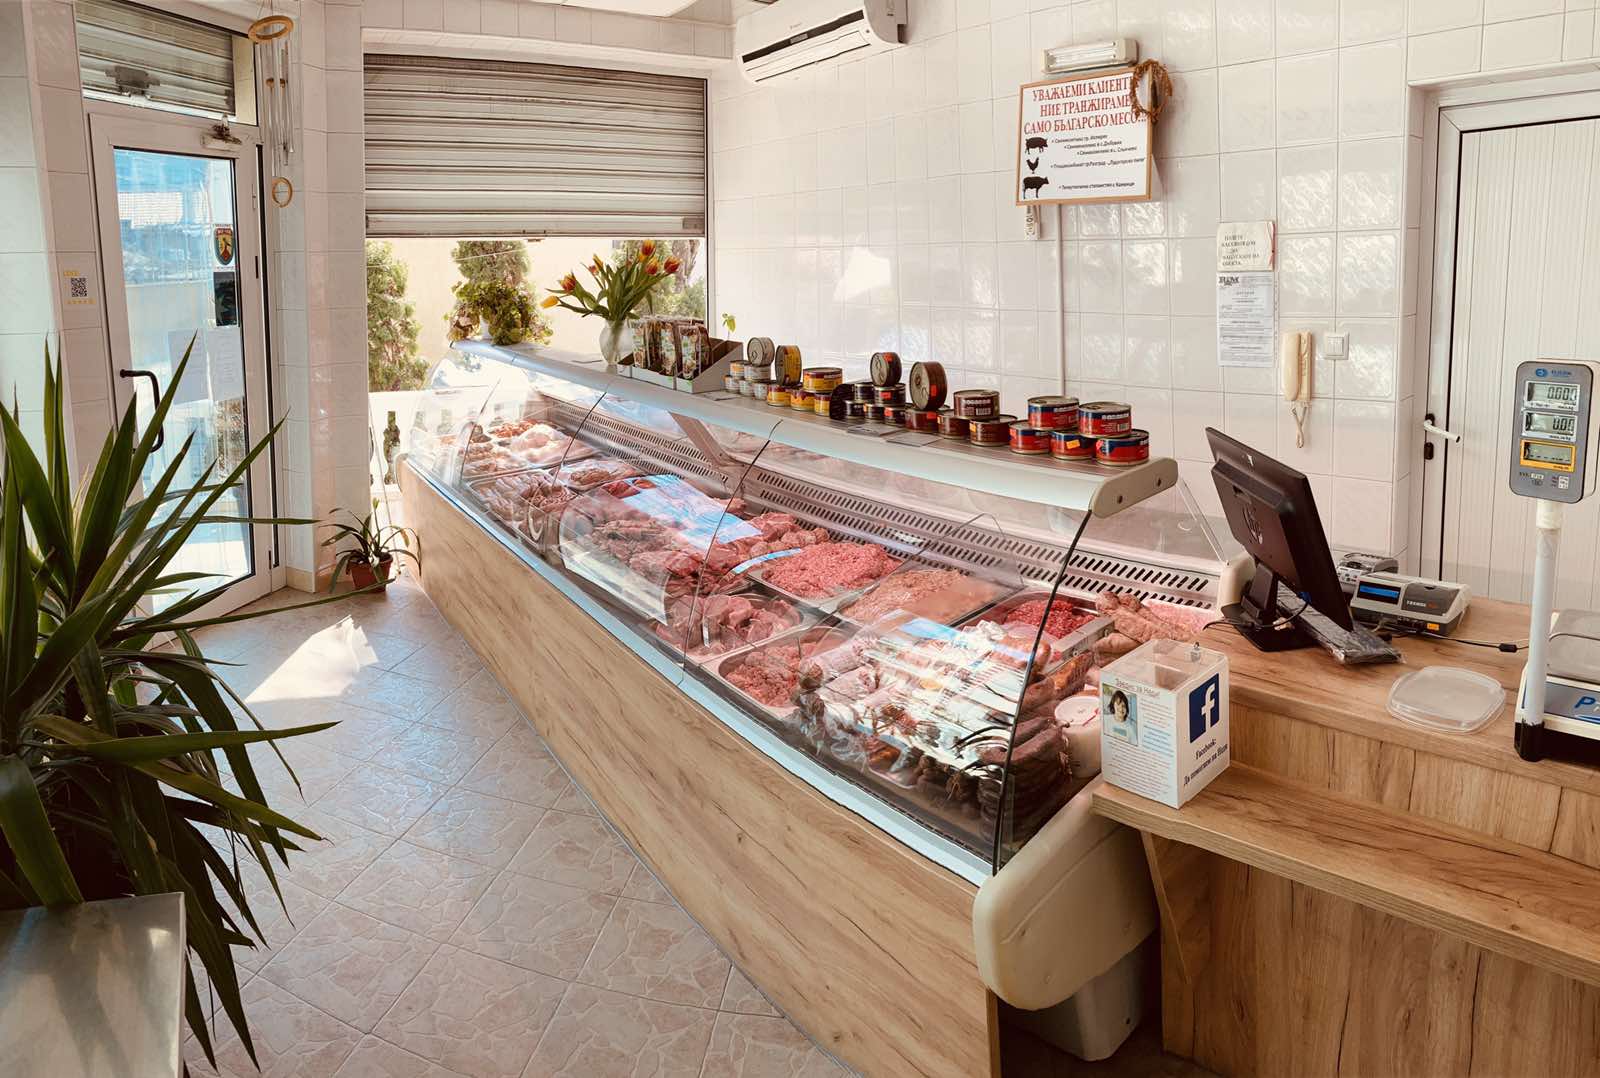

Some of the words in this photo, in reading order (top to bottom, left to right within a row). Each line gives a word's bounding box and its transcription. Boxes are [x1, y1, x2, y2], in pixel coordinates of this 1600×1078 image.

[1032, 83, 1086, 102] УВАЖАЕМИ
[1088, 76, 1131, 95] КЛИЕНТ
[1040, 102, 1064, 117] НИЕ
[1063, 94, 1131, 115] ТРАНЖИРАМЕ
[1024, 120, 1052, 135] САМО
[1054, 115, 1109, 132] БЪЛГАРСКО
